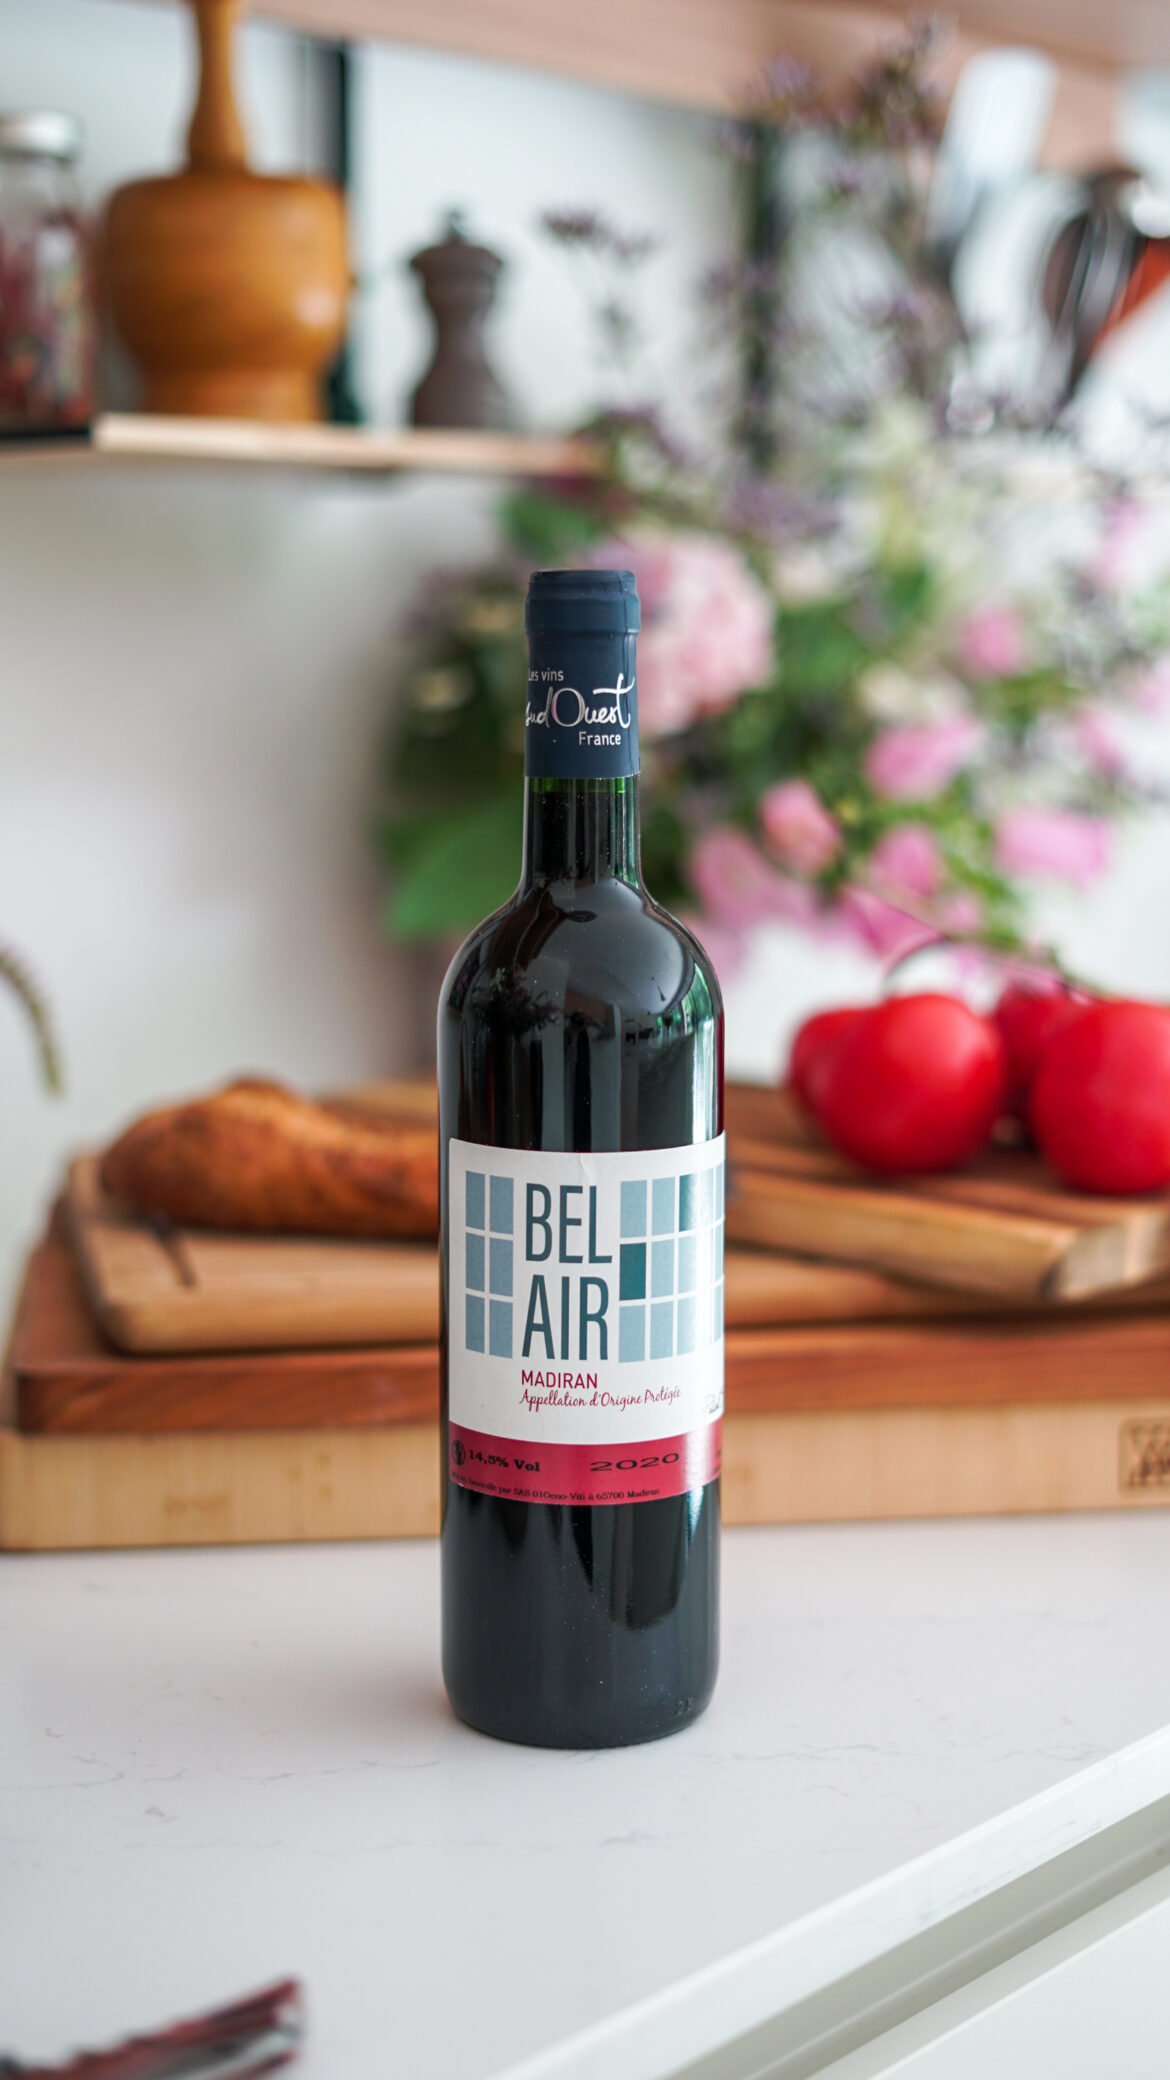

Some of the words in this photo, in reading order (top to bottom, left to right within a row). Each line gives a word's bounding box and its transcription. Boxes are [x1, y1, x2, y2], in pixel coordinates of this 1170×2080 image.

[541, 667, 564, 682] vins
[578, 731, 622, 746] France
[525, 1182, 613, 1264] BEL
[521, 1274, 609, 1361] AIR
[521, 1369, 598, 1389] MADIRAN
[519, 1388, 587, 1413] Appellation
[589, 1391, 642, 1412] d'Origine
[513, 1459, 541, 1473] Vol
[589, 1452, 680, 1472] 2020
[626, 1488, 660, 1499] Madiran
